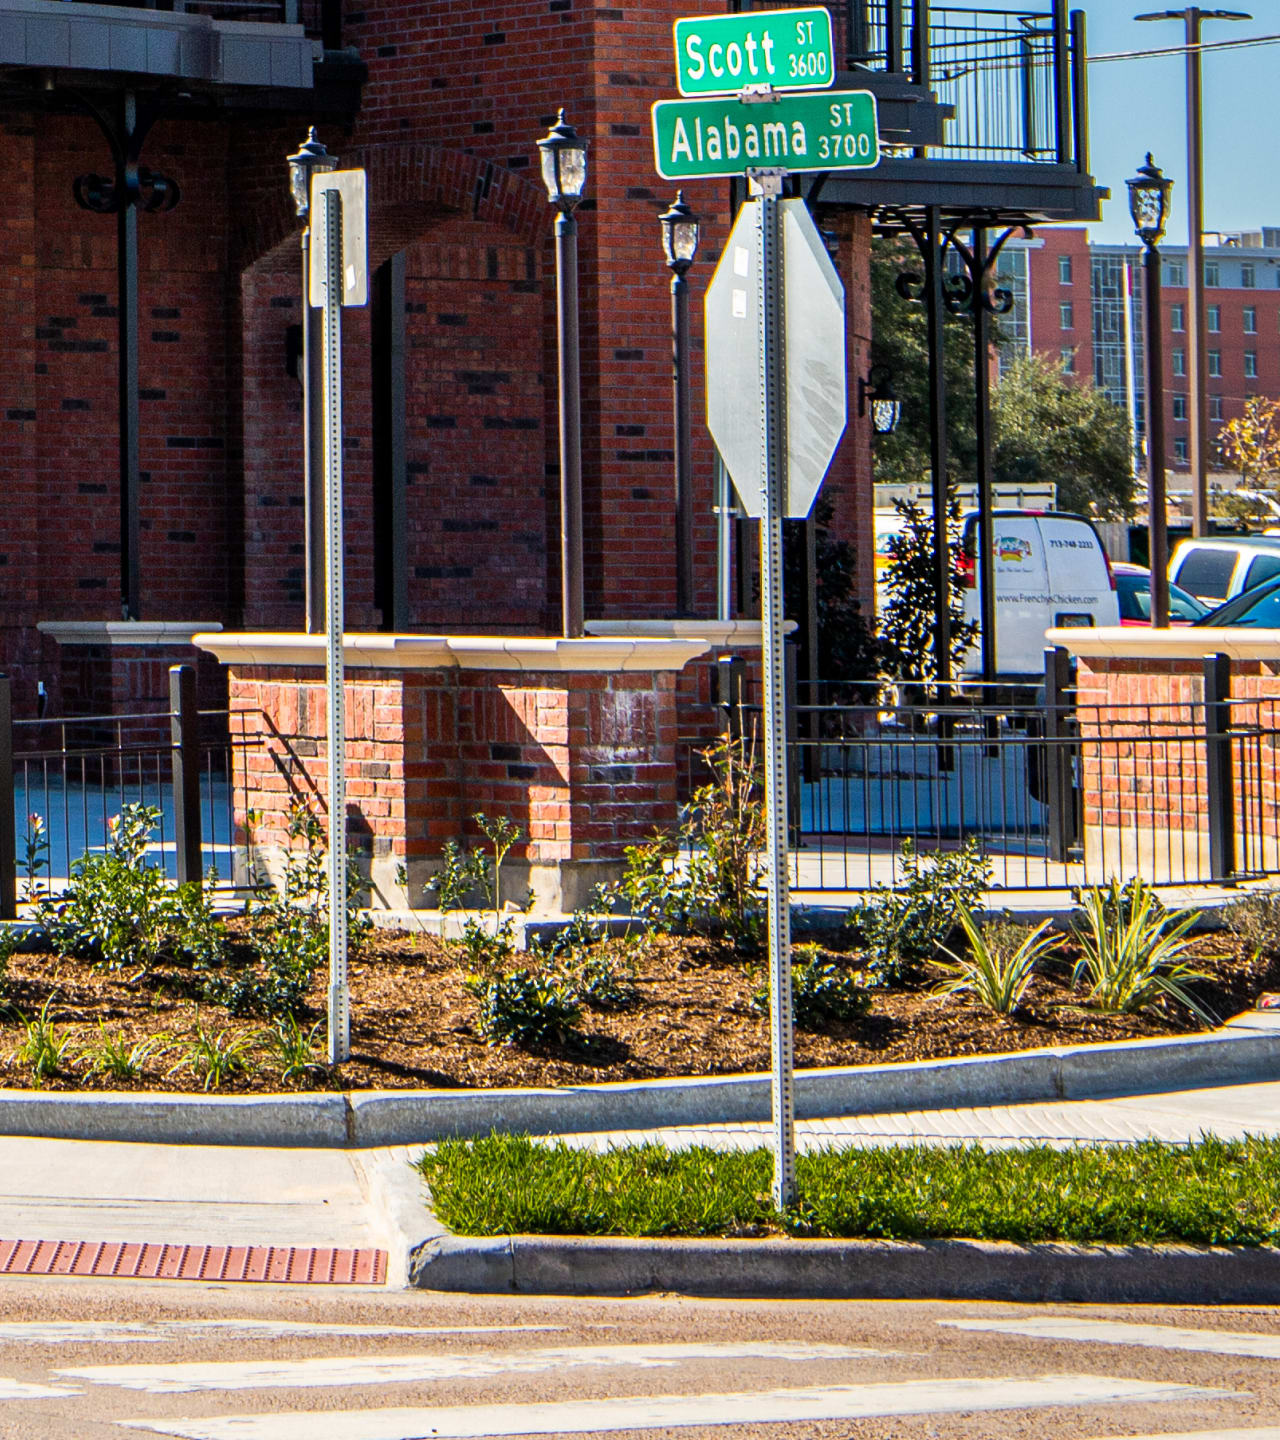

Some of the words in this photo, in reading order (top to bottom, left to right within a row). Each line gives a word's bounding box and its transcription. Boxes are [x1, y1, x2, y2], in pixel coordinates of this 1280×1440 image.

[685, 29, 776, 80] Scott
[795, 20, 814, 46] ST
[788, 51, 827, 78] 3600
[671, 114, 808, 163] Alabama
[829, 102, 853, 128] ST
[817, 132, 870, 159] 3700
